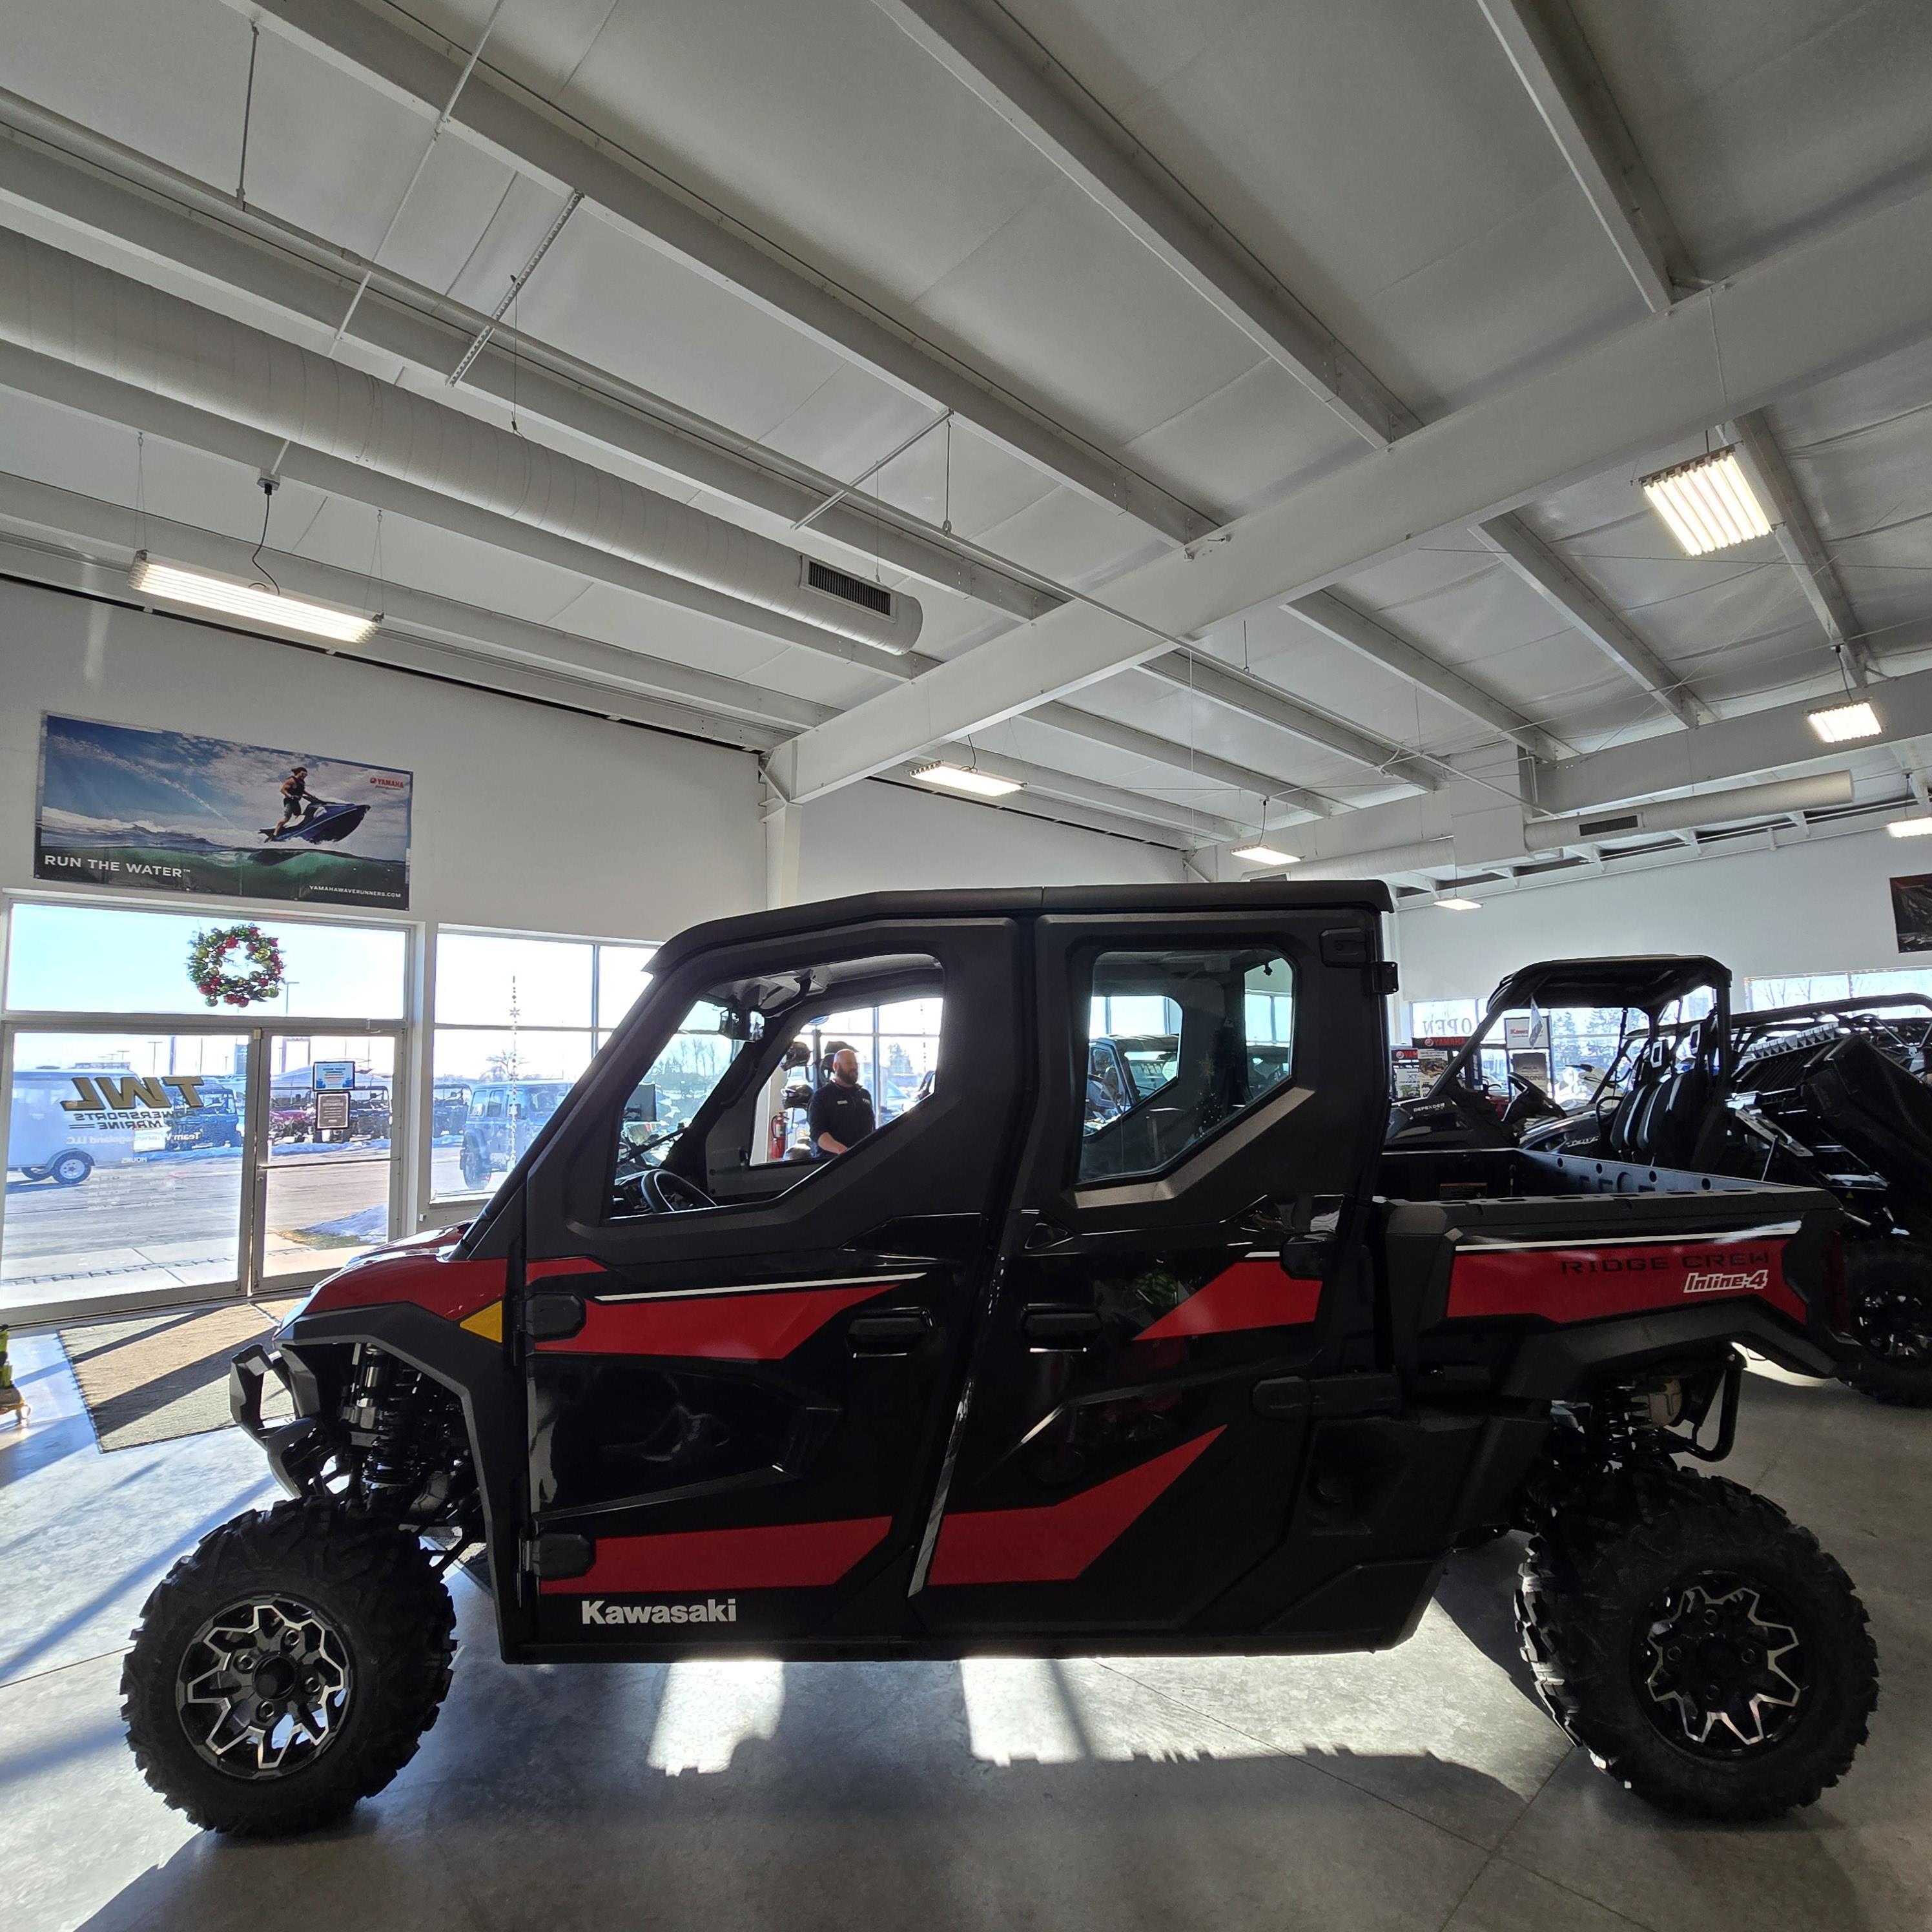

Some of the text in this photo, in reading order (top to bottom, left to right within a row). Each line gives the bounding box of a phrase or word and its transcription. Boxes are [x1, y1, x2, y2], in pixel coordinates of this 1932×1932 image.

[377, 778, 404, 788] YAMAHA
[44, 855, 81, 867] RUN
[87, 859, 120, 871] THE
[309, 885, 402, 898] YAMAHAWAVERUNNERS.COM
[1434, 1037, 1466, 1045] YAMAHA
[1404, 1051, 1418, 1059] YAM
[1561, 1251, 1769, 1275] RIDGE CREW
[1683, 1269, 1769, 1293] Inline-4
[582, 1598, 737, 1625] Kawasaki
